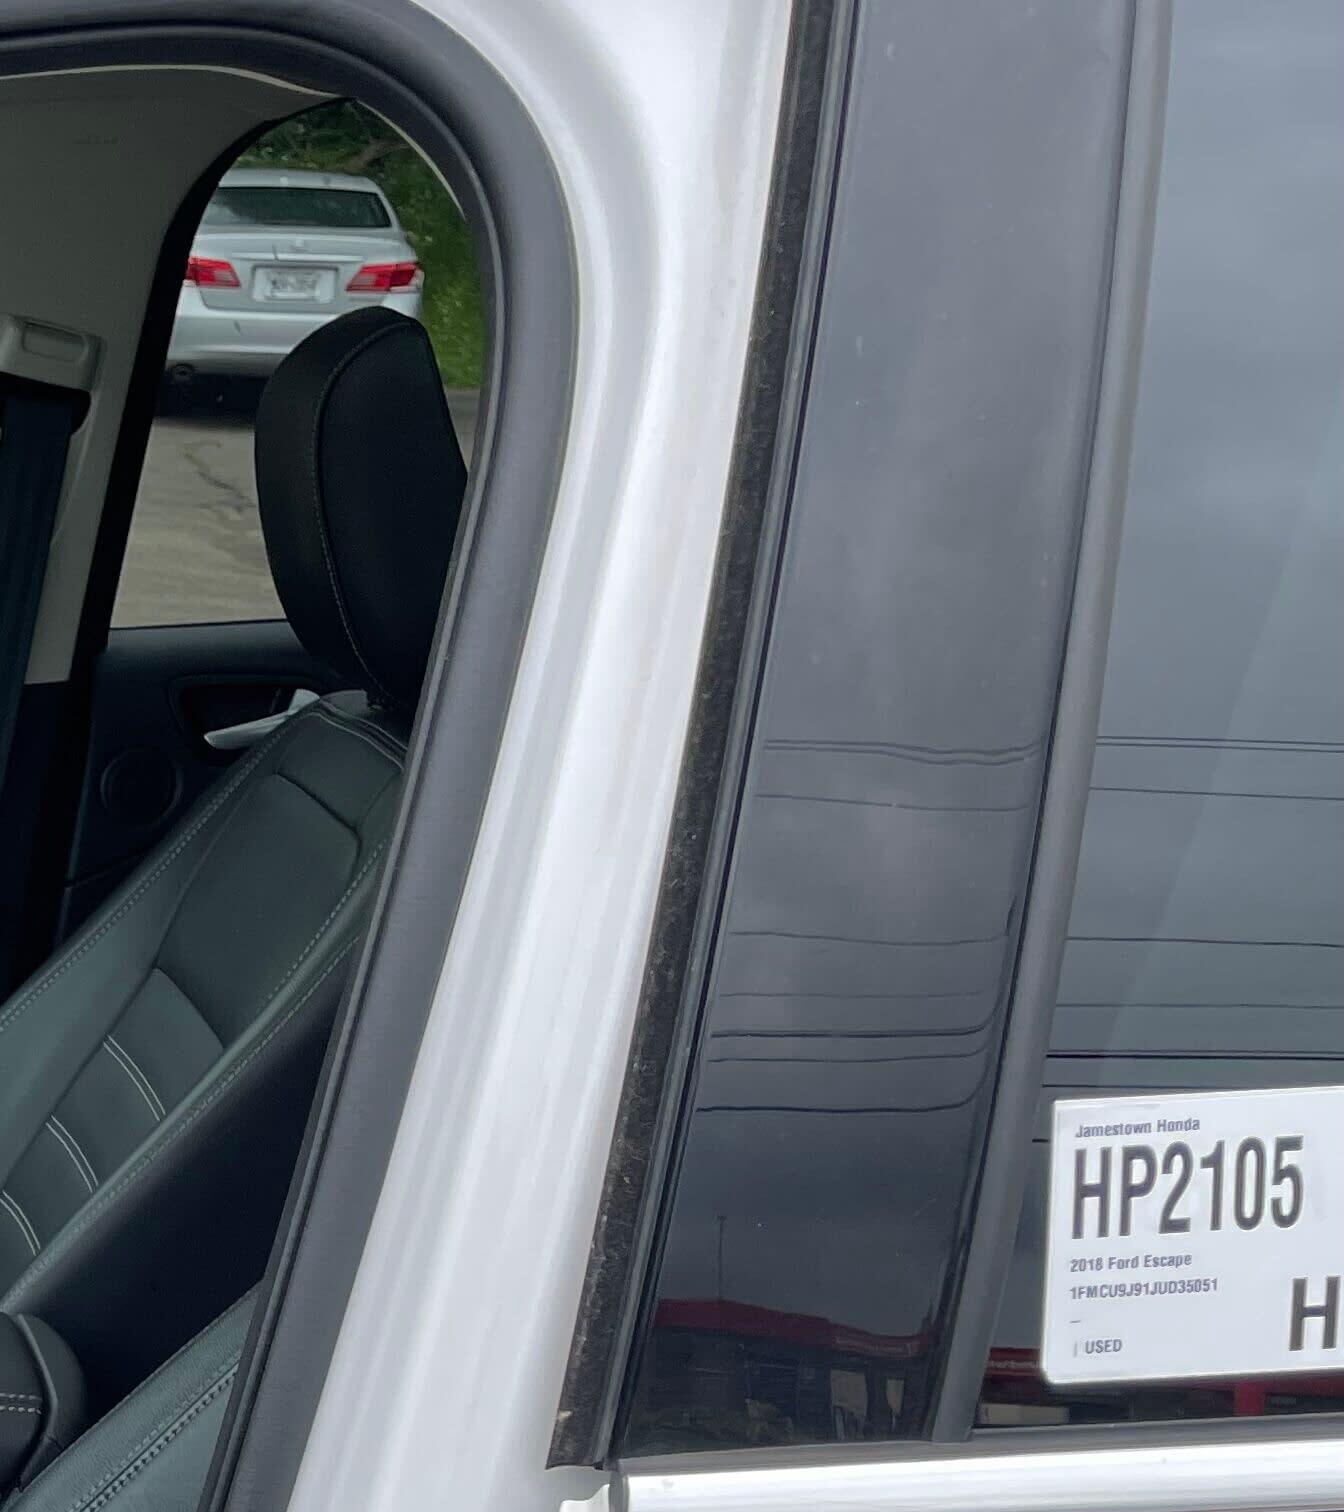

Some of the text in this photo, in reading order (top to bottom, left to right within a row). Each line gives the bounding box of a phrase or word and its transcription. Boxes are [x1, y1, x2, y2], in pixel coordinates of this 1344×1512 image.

[1076, 1118, 1200, 1138] Jamestown Honda
[1072, 1135, 1304, 1240] HP2105
[1070, 1254, 1192, 1272] 2018 Ford Escape
[1085, 1339, 1122, 1354] USED
